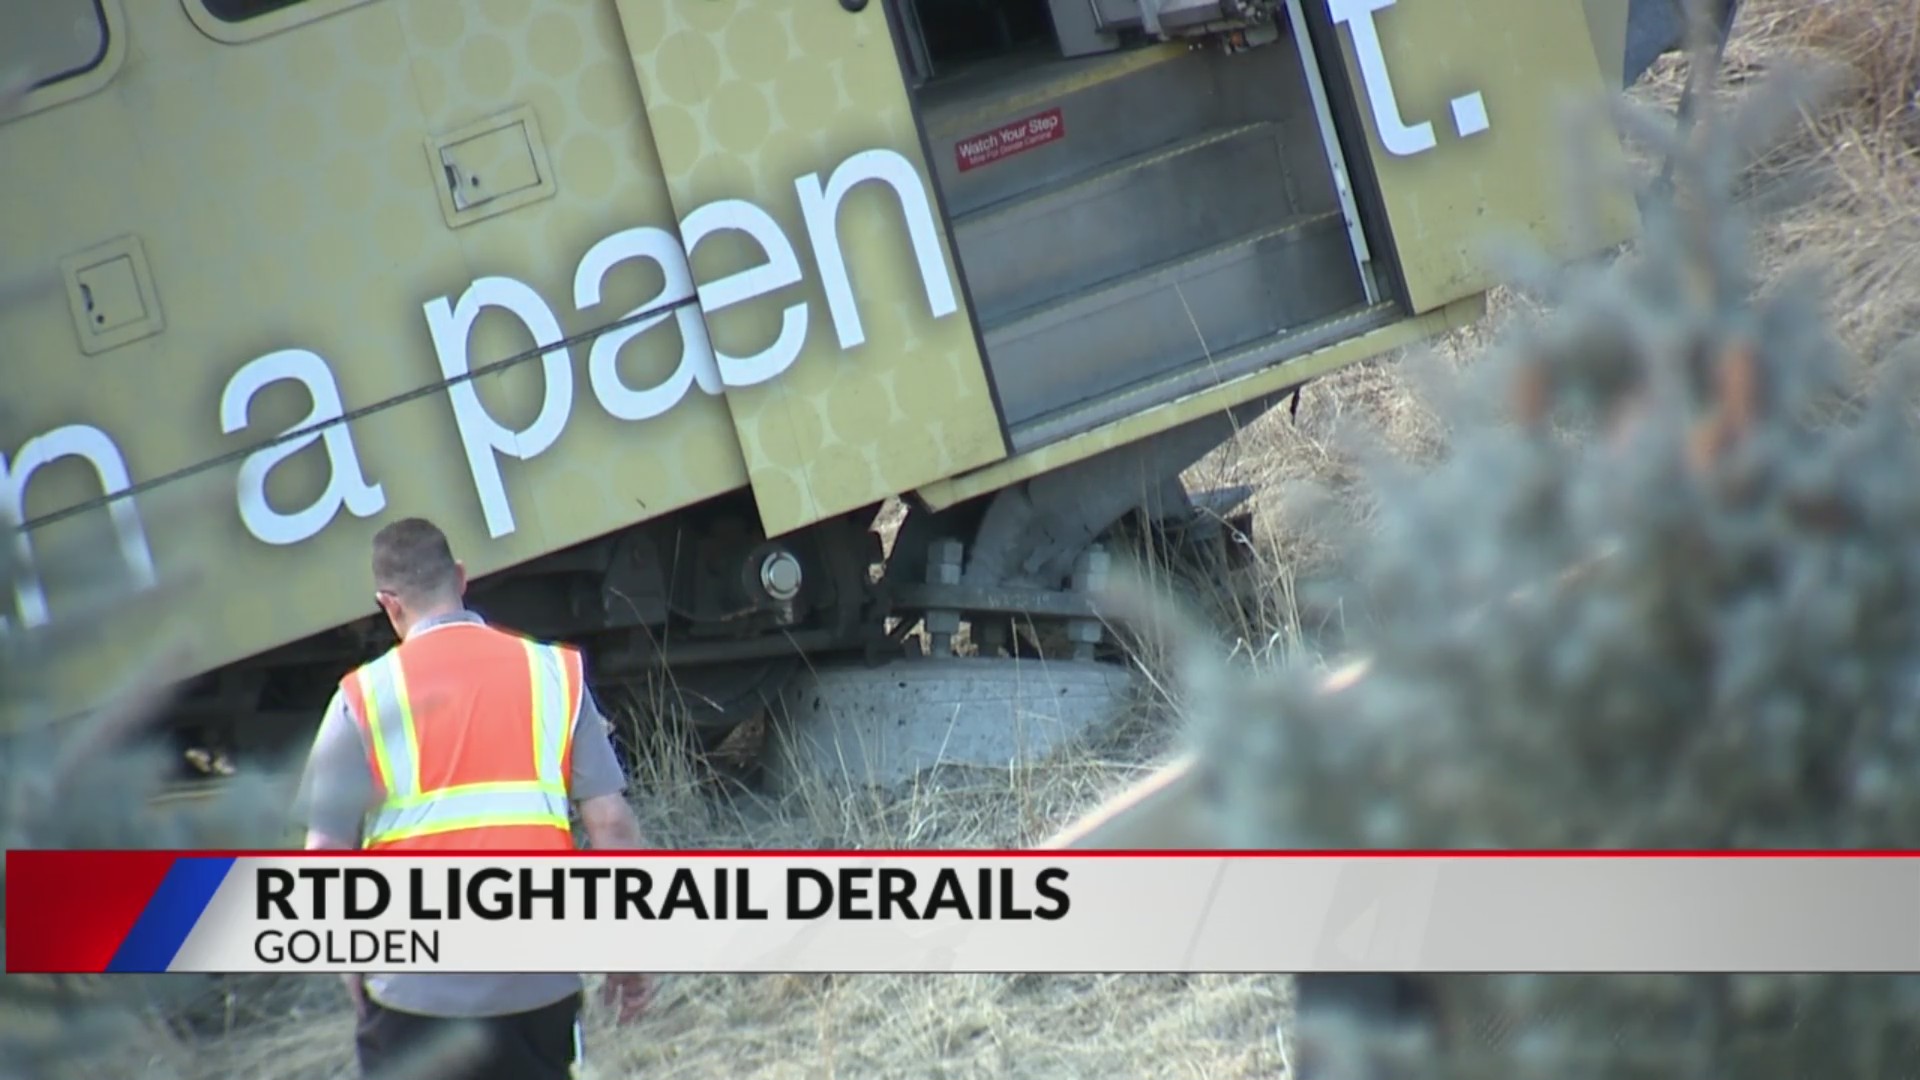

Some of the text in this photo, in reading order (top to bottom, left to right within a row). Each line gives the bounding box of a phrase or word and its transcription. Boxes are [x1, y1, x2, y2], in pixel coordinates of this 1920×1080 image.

[959, 135, 998, 157] Watch
[1000, 125, 1026, 143] Your
[1029, 115, 1058, 134] Step
[221, 348, 387, 544] a
